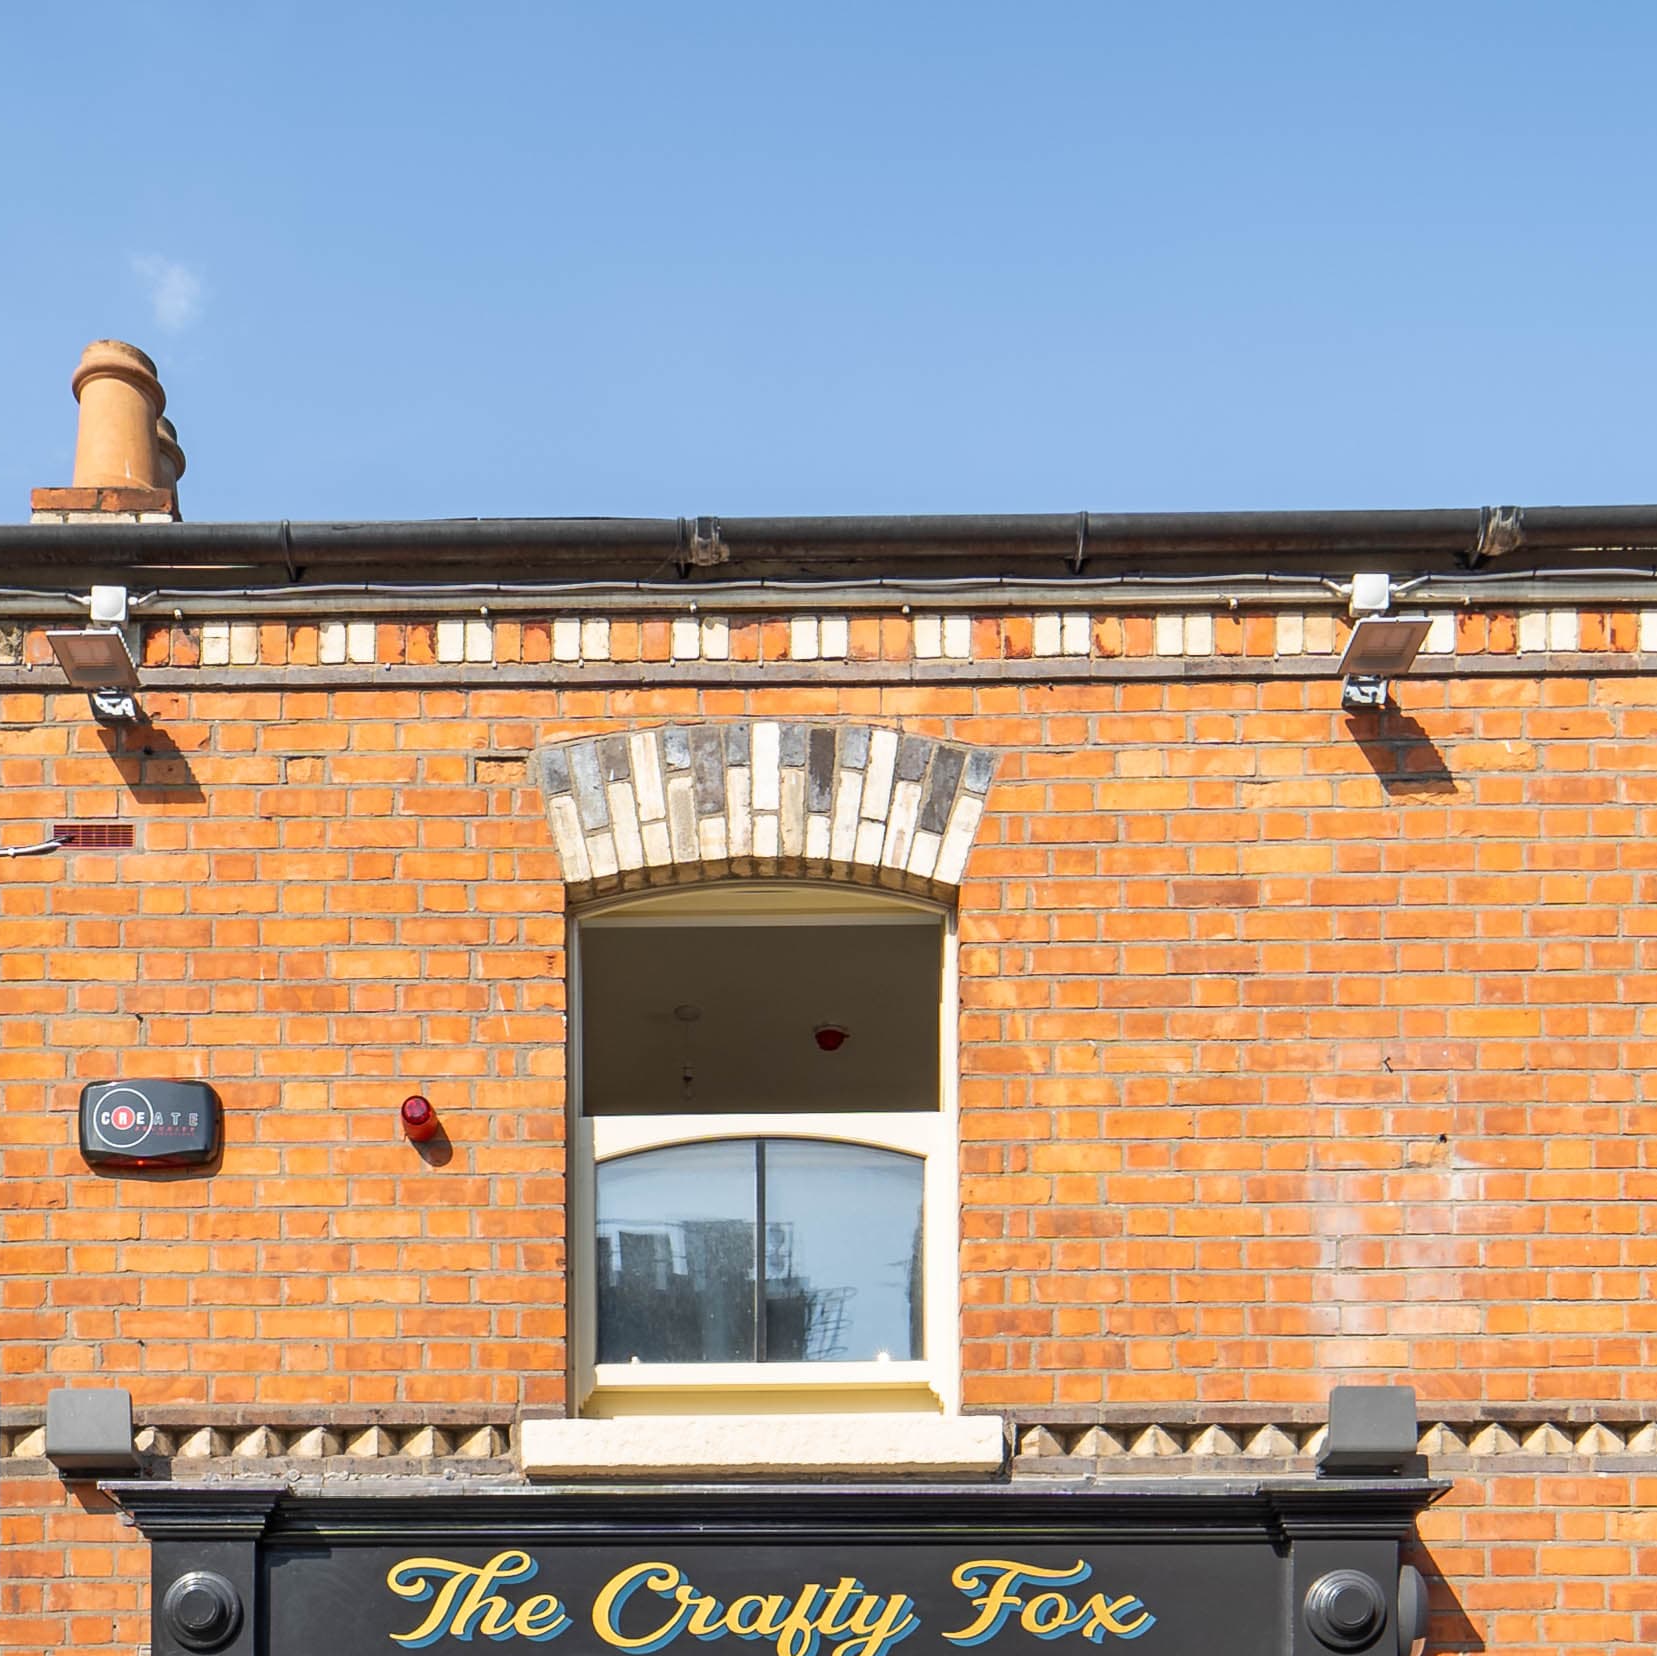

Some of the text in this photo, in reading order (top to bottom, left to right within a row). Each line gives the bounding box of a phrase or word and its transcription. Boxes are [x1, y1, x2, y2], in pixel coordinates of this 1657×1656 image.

[101, 1111, 200, 1127] CREATE
[386, 1549, 573, 1649] The
[942, 1558, 1158, 1645] Fox
